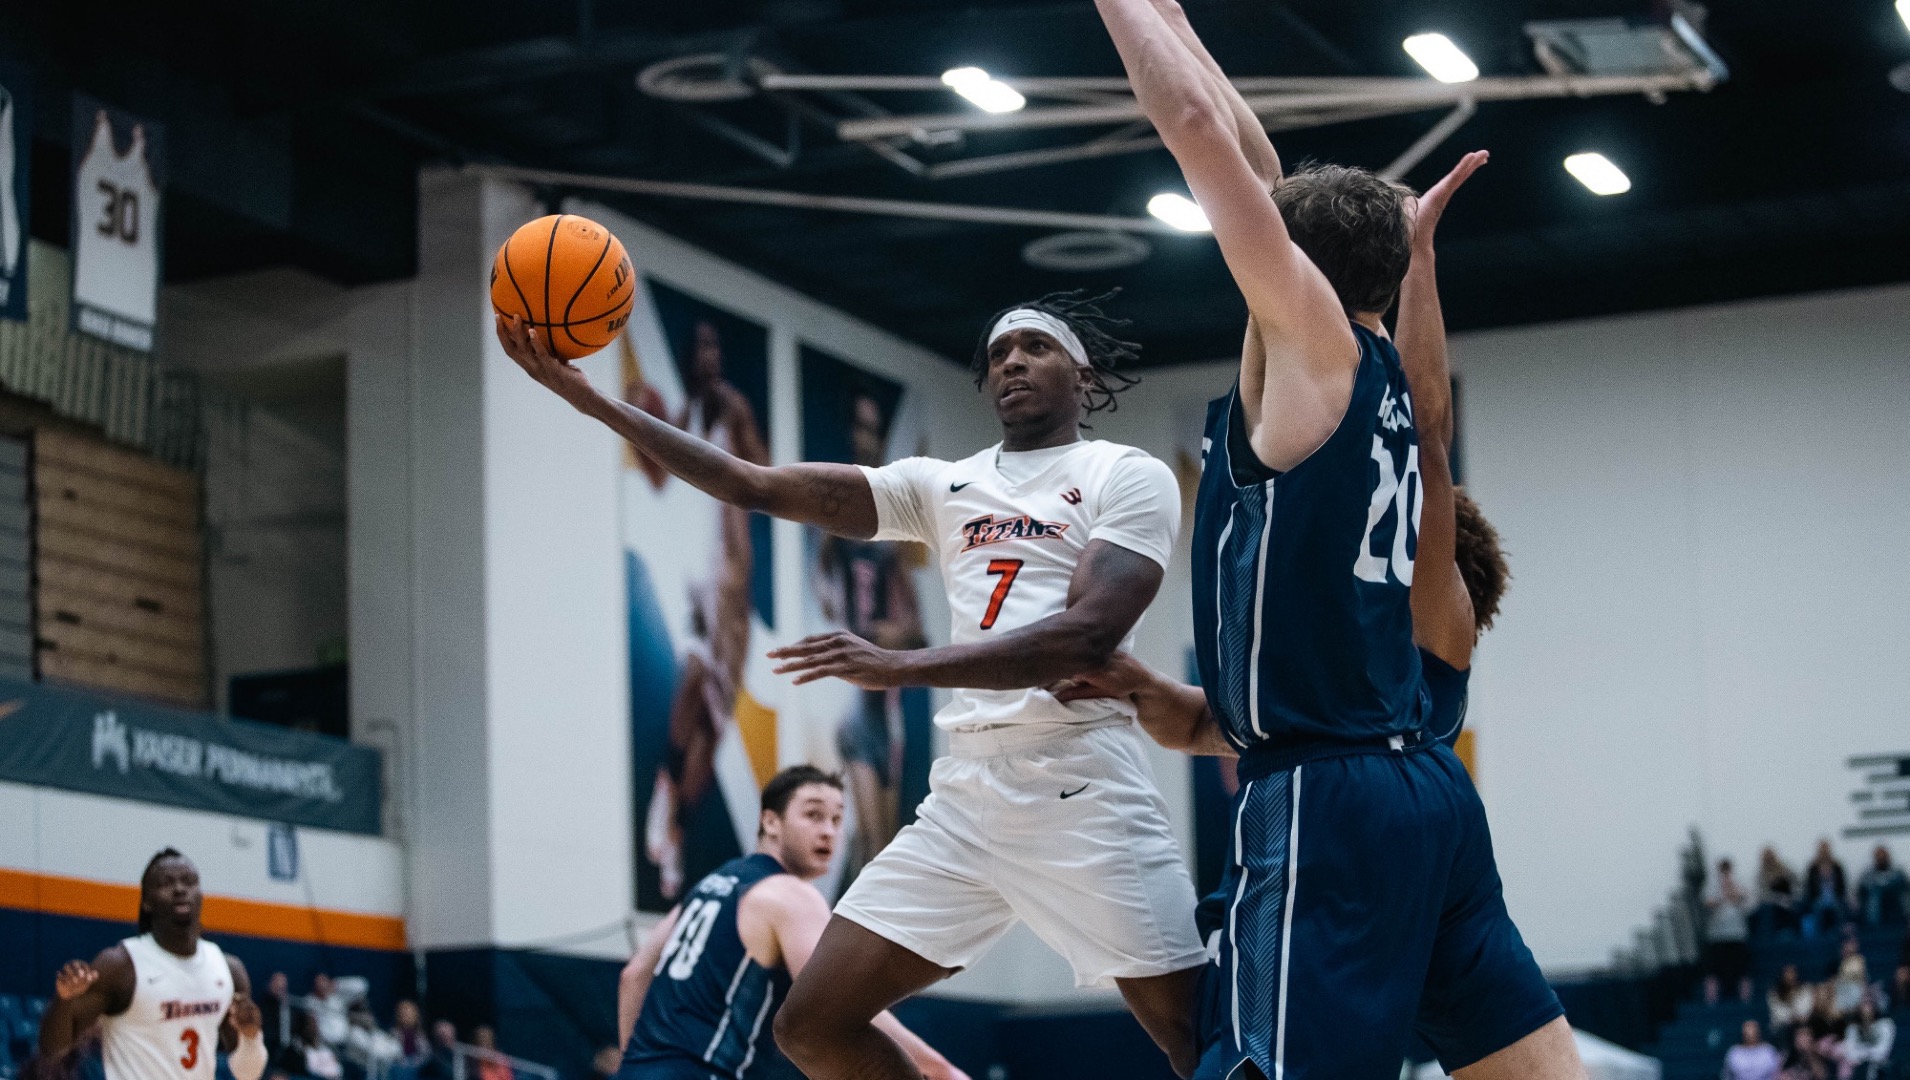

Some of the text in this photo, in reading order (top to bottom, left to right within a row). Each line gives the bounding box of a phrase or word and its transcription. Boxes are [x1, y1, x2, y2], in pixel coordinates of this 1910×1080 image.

[97, 180, 138, 245] 30
[961, 514, 1070, 553] TITANS
[1353, 433, 1423, 587] 20
[980, 559, 1024, 630] 7
[180, 1028, 199, 1070] 3
